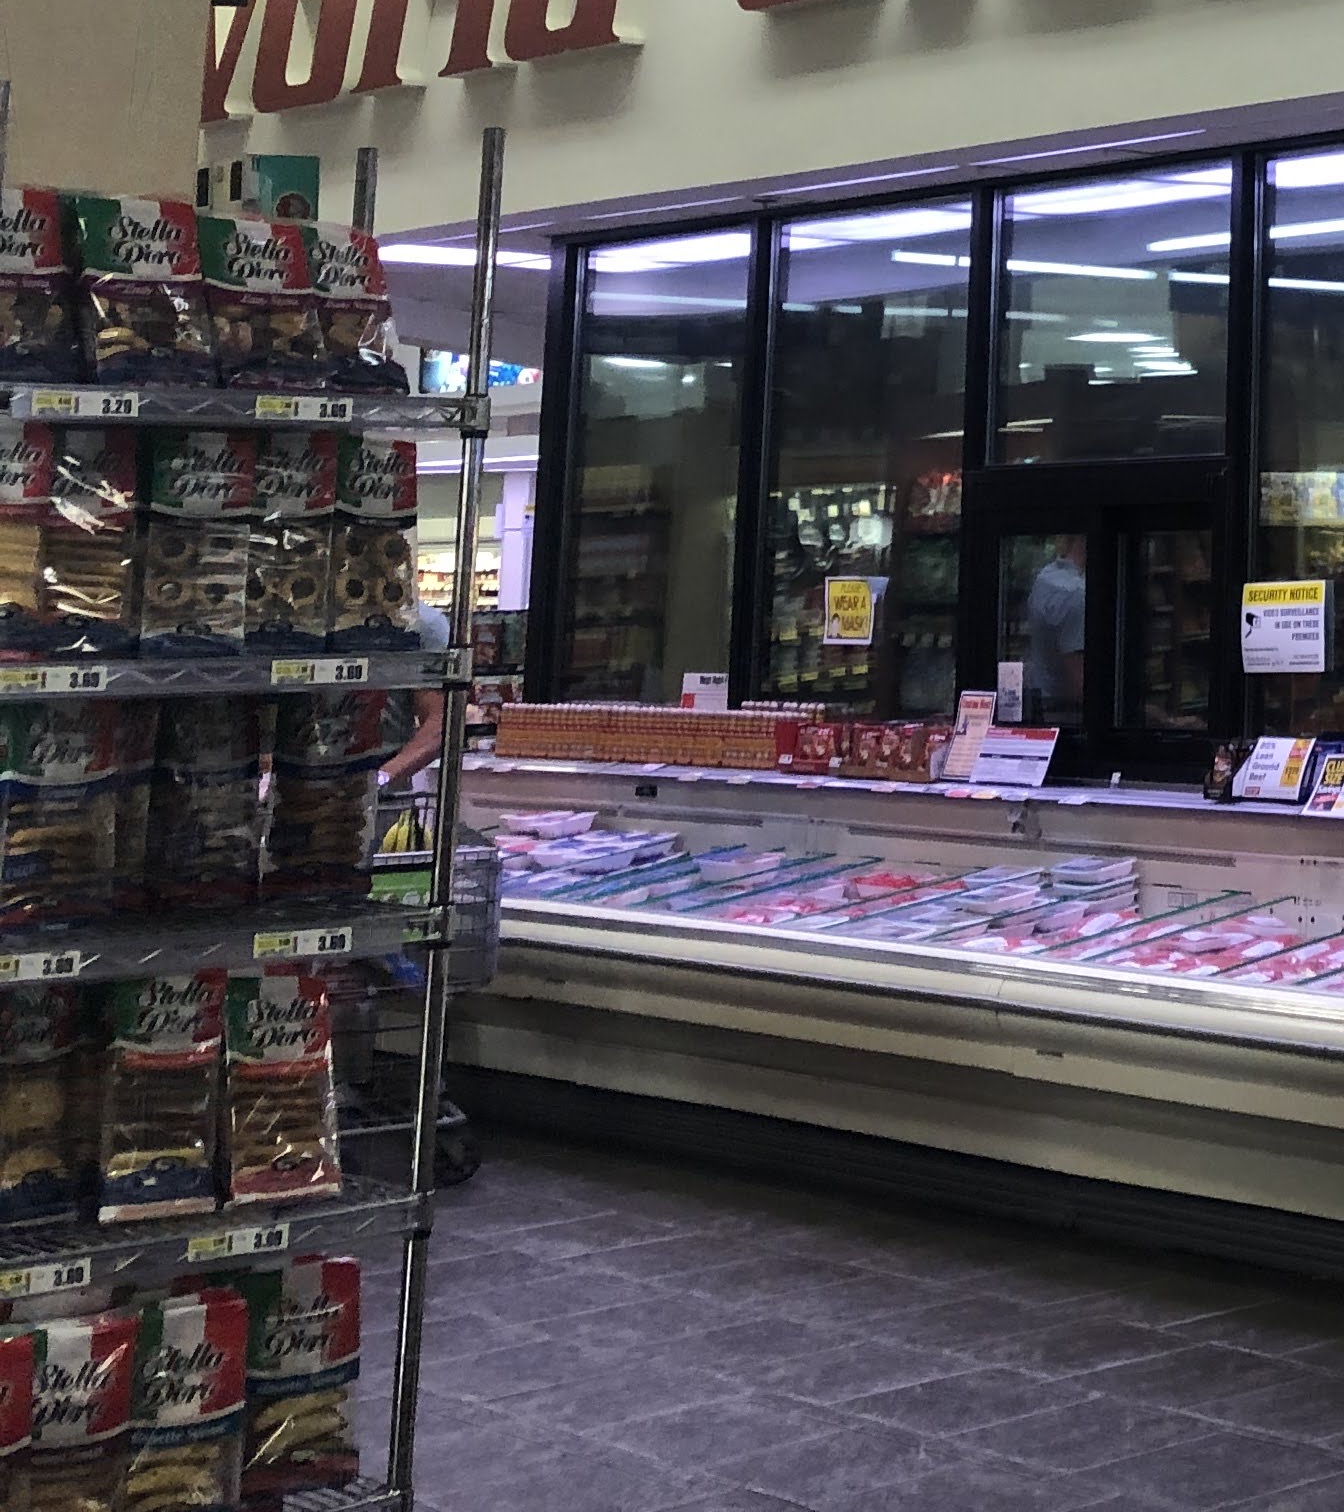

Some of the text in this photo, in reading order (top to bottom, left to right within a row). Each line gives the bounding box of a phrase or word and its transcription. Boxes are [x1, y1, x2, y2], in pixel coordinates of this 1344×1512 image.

[0, 207, 47, 233] ella
[107, 215, 184, 241] Stella
[223, 232, 292, 262] Stella
[1248, 587, 1319, 603] SECURITY NOTICE
[138, 980, 216, 1008] Stella
